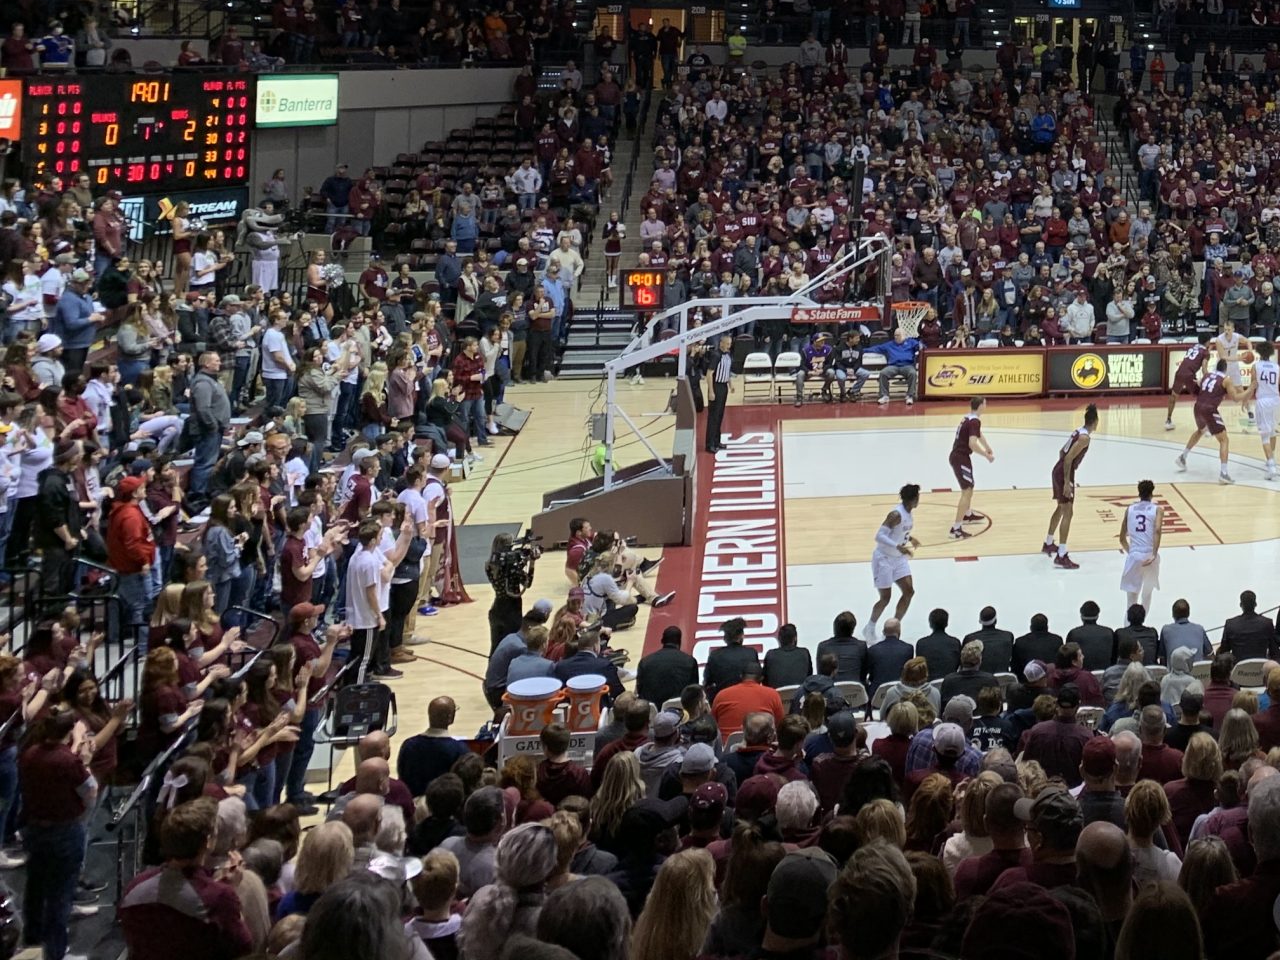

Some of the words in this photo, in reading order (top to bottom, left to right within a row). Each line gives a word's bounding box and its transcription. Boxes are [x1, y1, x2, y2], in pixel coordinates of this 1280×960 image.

[131, 82, 170, 103] 19:01
[278, 98, 333, 112] Banterra
[206, 116, 218, 126] 21
[105, 124, 119, 146] 0
[145, 127, 150, 140] 1
[184, 121, 196, 141] 2
[206, 133, 218, 144] 30
[205, 150, 217, 162] 33
[97, 167, 108, 184] 0
[127, 164, 145, 182] 30
[185, 161, 195, 177] 0
[204, 169, 217, 179] 44
[627, 273, 661, 286] 19:01
[637, 289, 652, 305] 16
[1108, 354, 1143, 362] BUFFALO
[1108, 361, 1143, 374] WILD
[968, 375, 994, 385] SIU
[998, 373, 1040, 384] ATHLETICS
[1108, 373, 1143, 383] WINGS
[1201, 377, 1217, 392] 44
[1260, 370, 1277, 385] 40
[709, 432, 776, 513] ILLINOIS
[1136, 515, 1146, 532] 3
[692, 518, 779, 681] OUTHERN
[523, 709, 535, 721] G
[578, 702, 590, 715] G
[515, 738, 586, 752] GATDE
